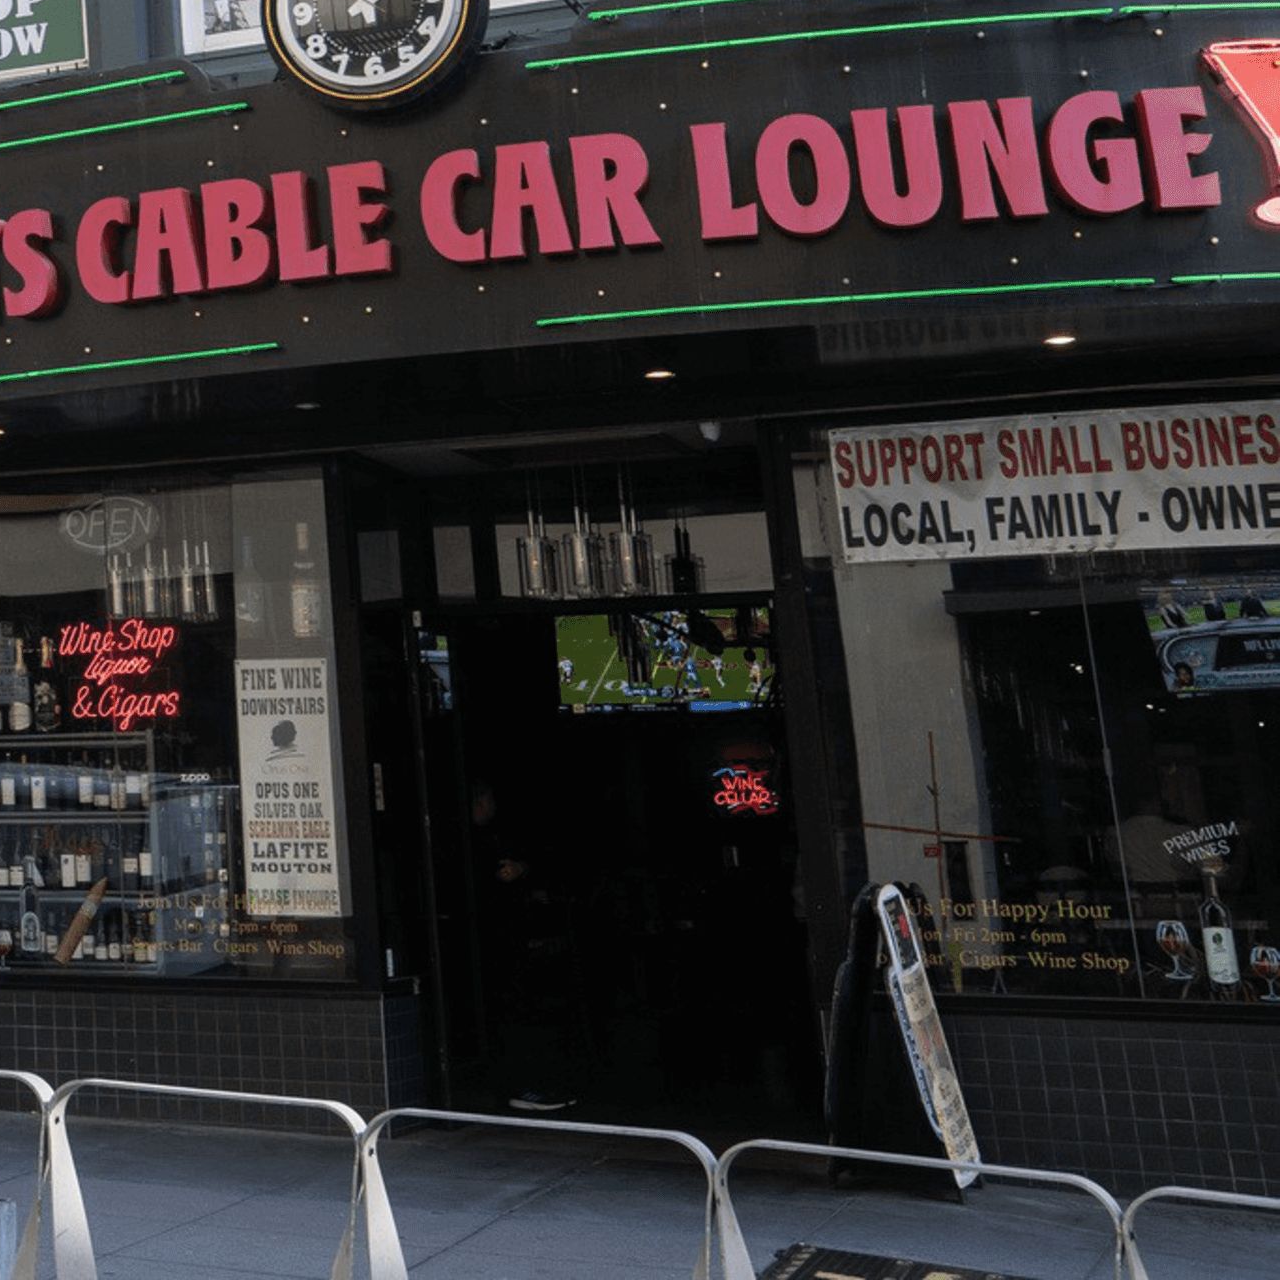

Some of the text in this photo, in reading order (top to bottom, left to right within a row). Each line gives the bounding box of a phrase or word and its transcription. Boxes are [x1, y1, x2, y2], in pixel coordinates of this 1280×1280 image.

[292, 2, 313, 26] 9
[417, 16, 437, 36] 4
[306, 34, 327, 59] 8
[398, 45, 417, 66] 5
[332, 53, 349, 76] 7
[364, 56, 385, 77] 6
[76, 161, 394, 304] CABLE
[420, 132, 663, 264] CAR
[690, 86, 1222, 240] LOUNGE
[834, 431, 986, 490] SUPPORT
[997, 424, 1114, 480] SMALL
[66, 506, 152, 540] OPEN
[842, 499, 975, 552] LOCAL,
[986, 489, 1121, 541] FAMILY
[59, 619, 174, 658] Wine Shop
[240, 667, 322, 690] FINE WINE
[73, 685, 179, 730] & Cigars
[241, 697, 325, 716] DOWNSTAIRS
[255, 782, 319, 799] OPUS ONE
[254, 802, 324, 819] SILVER OAK
[1162, 821, 1240, 855] PREMIUM
[253, 842, 329, 859] LAFITE
[1179, 840, 1231, 865] WINES
[251, 862, 332, 874] MOUTON
[941, 899, 976, 918] For
[982, 900, 1051, 923] Happy
[1056, 900, 1112, 920] Hour
[981, 928, 1015, 946] 2pm
[1030, 929, 1067, 946] 6pm
[178, 939, 204, 953] Bar
[213, 939, 258, 957] Cigars
[267, 939, 306, 955] Wine
[308, 941, 345, 959] Shop
[959, 951, 1017, 971] Cigars
[1027, 952, 1078, 970] Wine
[1082, 953, 1130, 973] Shop
